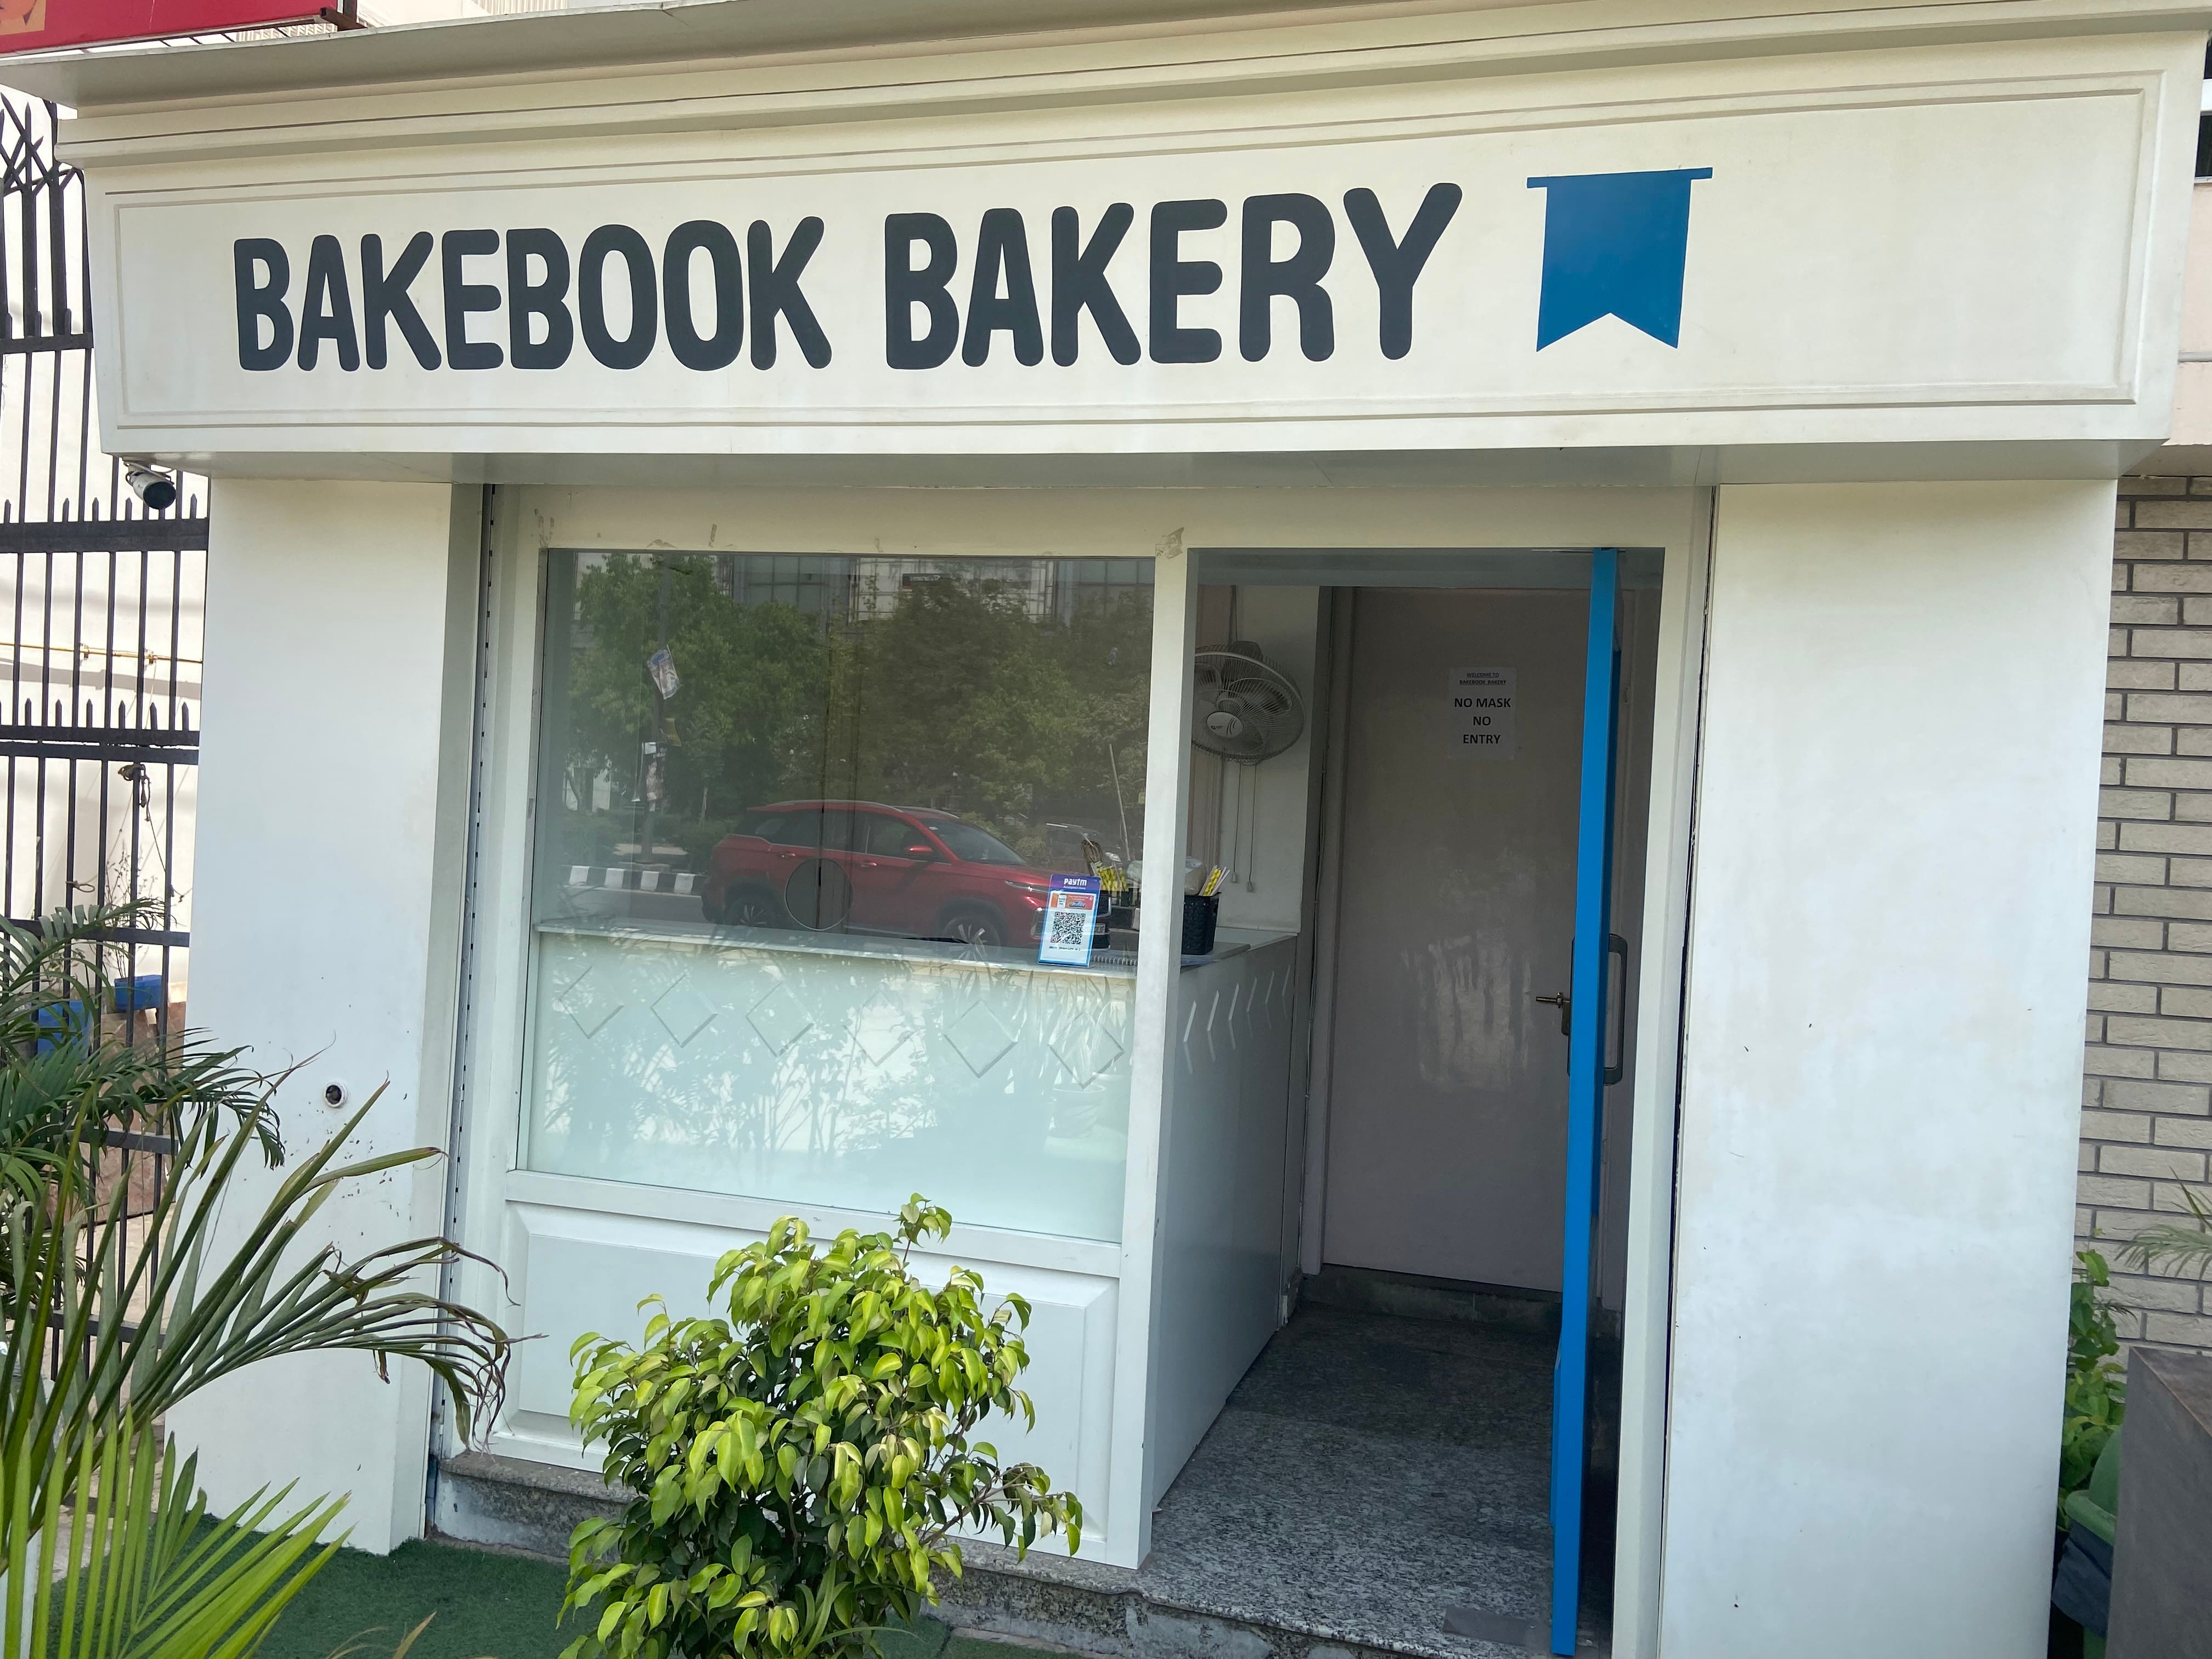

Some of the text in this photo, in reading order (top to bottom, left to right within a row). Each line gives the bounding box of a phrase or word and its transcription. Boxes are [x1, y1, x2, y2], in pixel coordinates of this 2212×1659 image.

[234, 183, 1462, 371] BAKEBOOK BAKERY
[1454, 698, 1511, 708] NO MASK
[1473, 716, 1491, 726] NO
[1463, 734, 1501, 744] ENTRY
